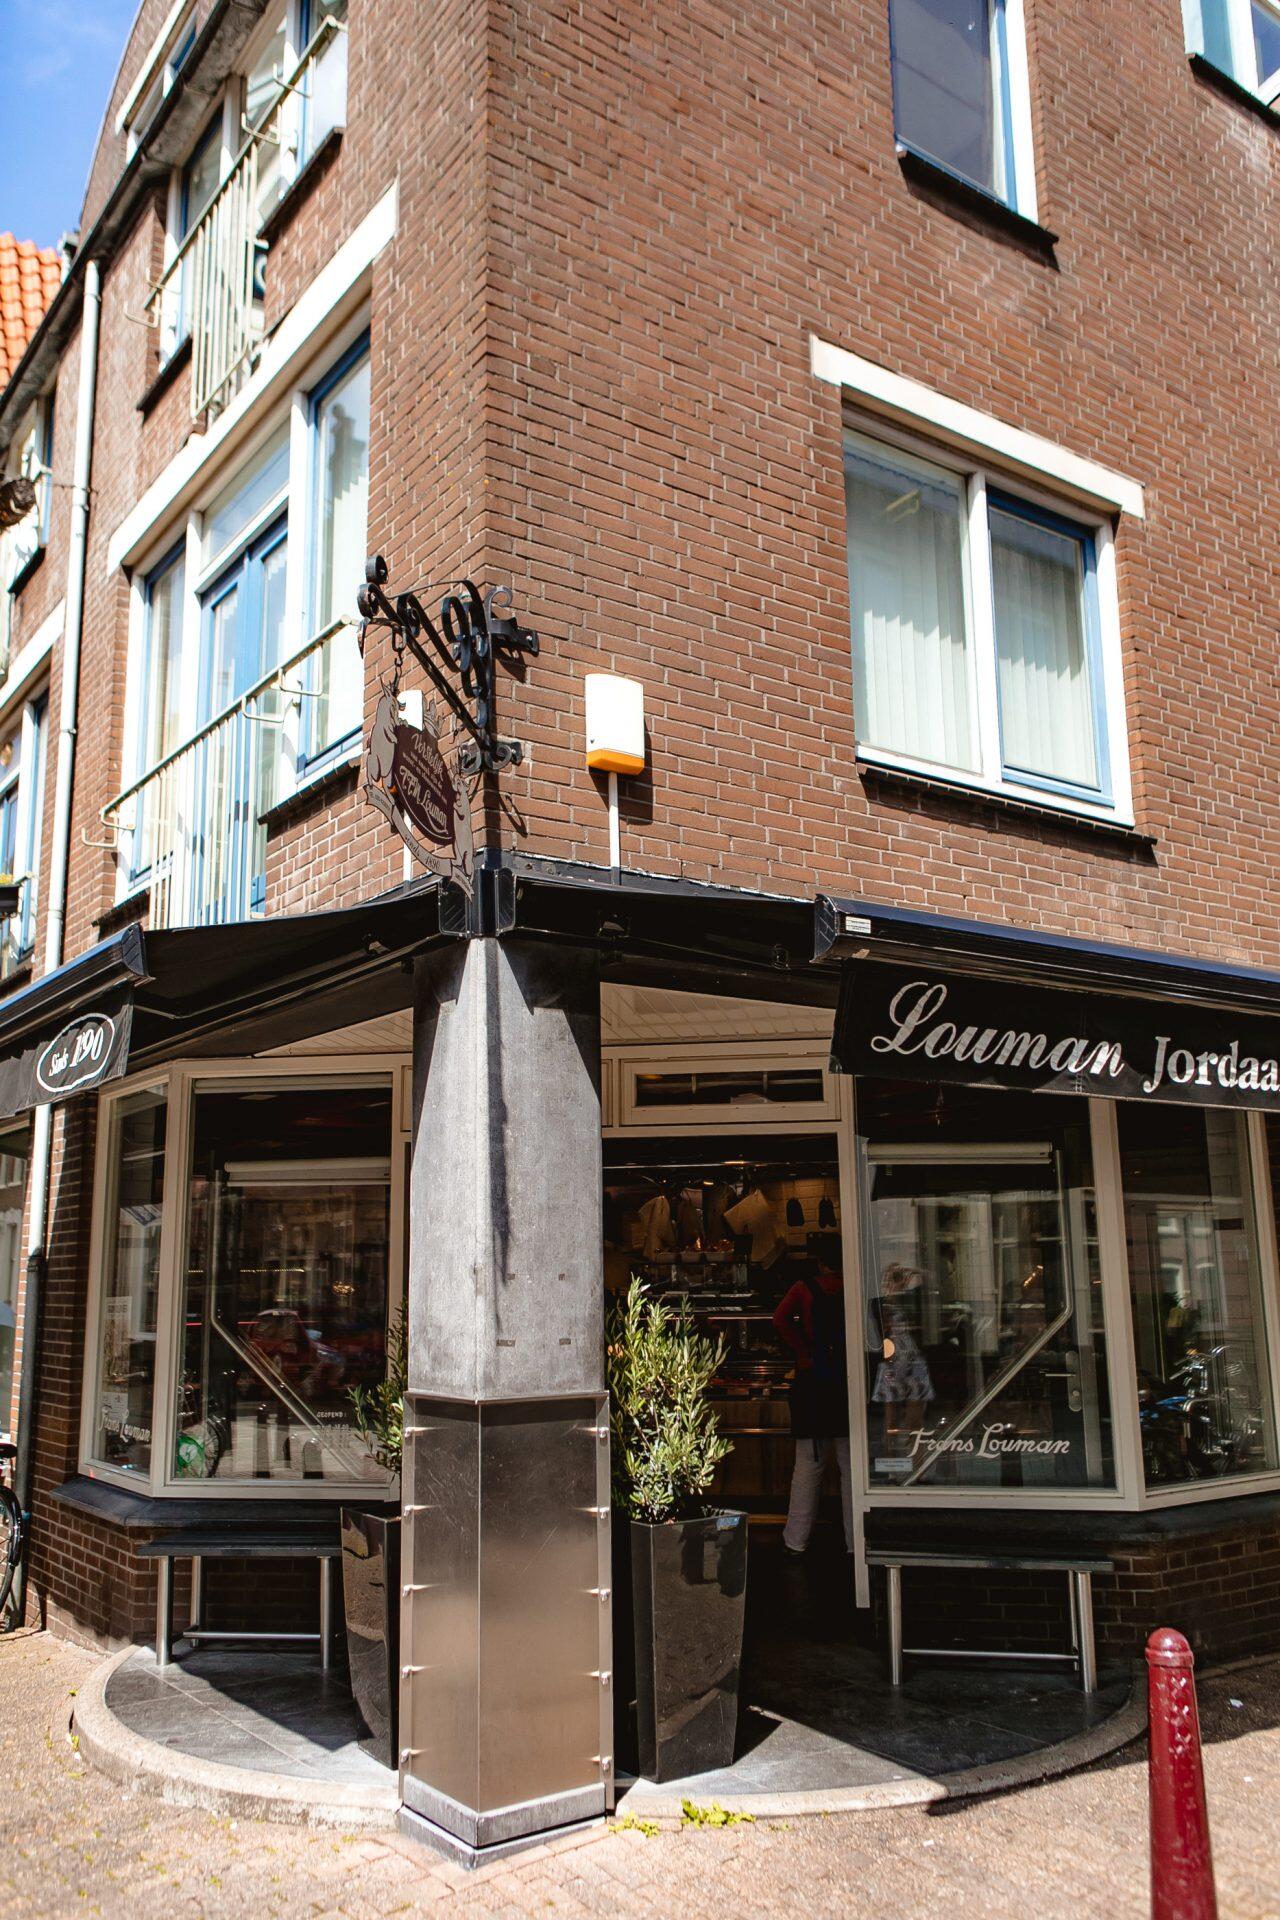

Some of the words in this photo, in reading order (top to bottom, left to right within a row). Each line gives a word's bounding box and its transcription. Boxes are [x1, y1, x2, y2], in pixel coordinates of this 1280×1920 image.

[871, 981, 1125, 1077] Louman
[1143, 1036, 1280, 1093] Jordaa
[907, 1427, 974, 1458] Frans
[976, 1423, 1070, 1459] Louman
